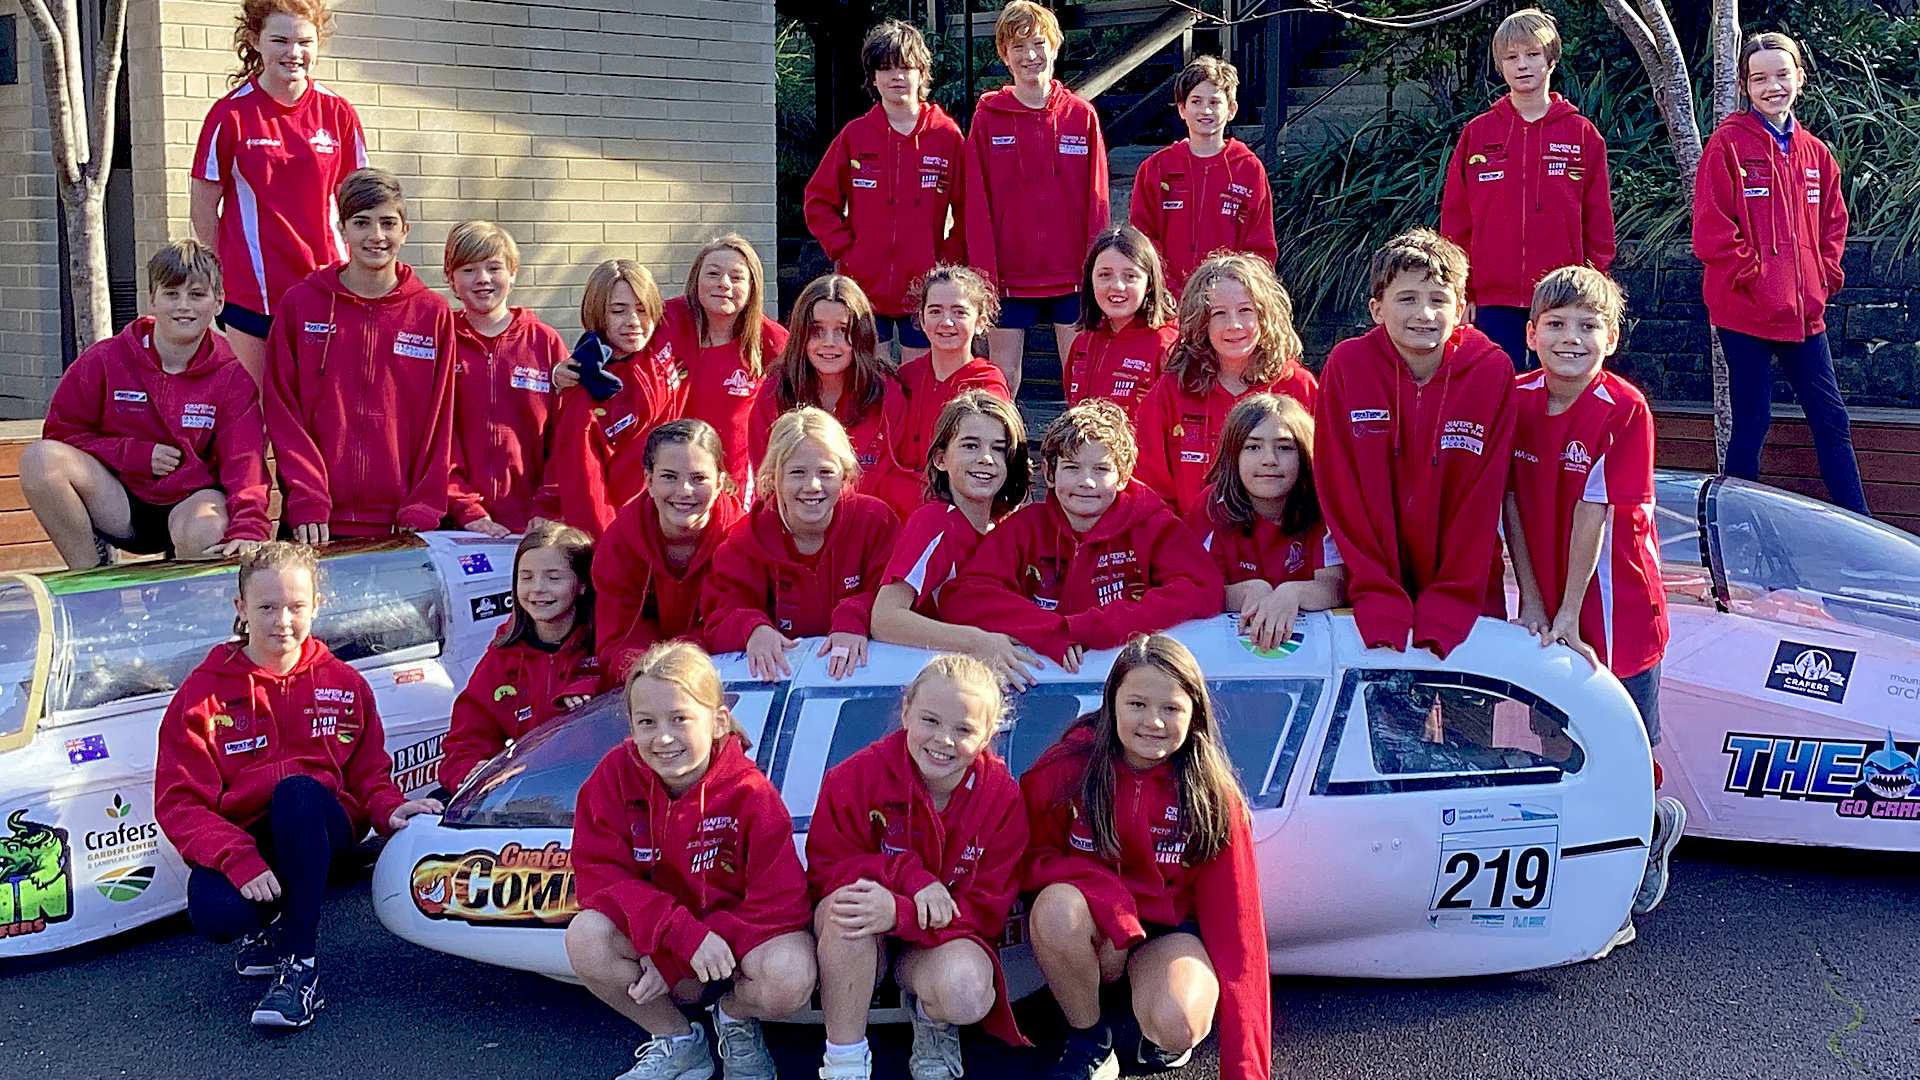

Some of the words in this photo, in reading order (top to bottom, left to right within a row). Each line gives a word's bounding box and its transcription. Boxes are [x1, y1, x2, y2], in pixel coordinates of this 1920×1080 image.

[1784, 677, 1830, 692] CRAFERS
[1726, 735, 1868, 797] THE
[1839, 799, 1868, 816] GO
[85, 822, 159, 851] Crafers
[87, 846, 125, 862] GARDEN
[126, 840, 159, 855] CENTRE
[1437, 847, 1550, 909] 219
